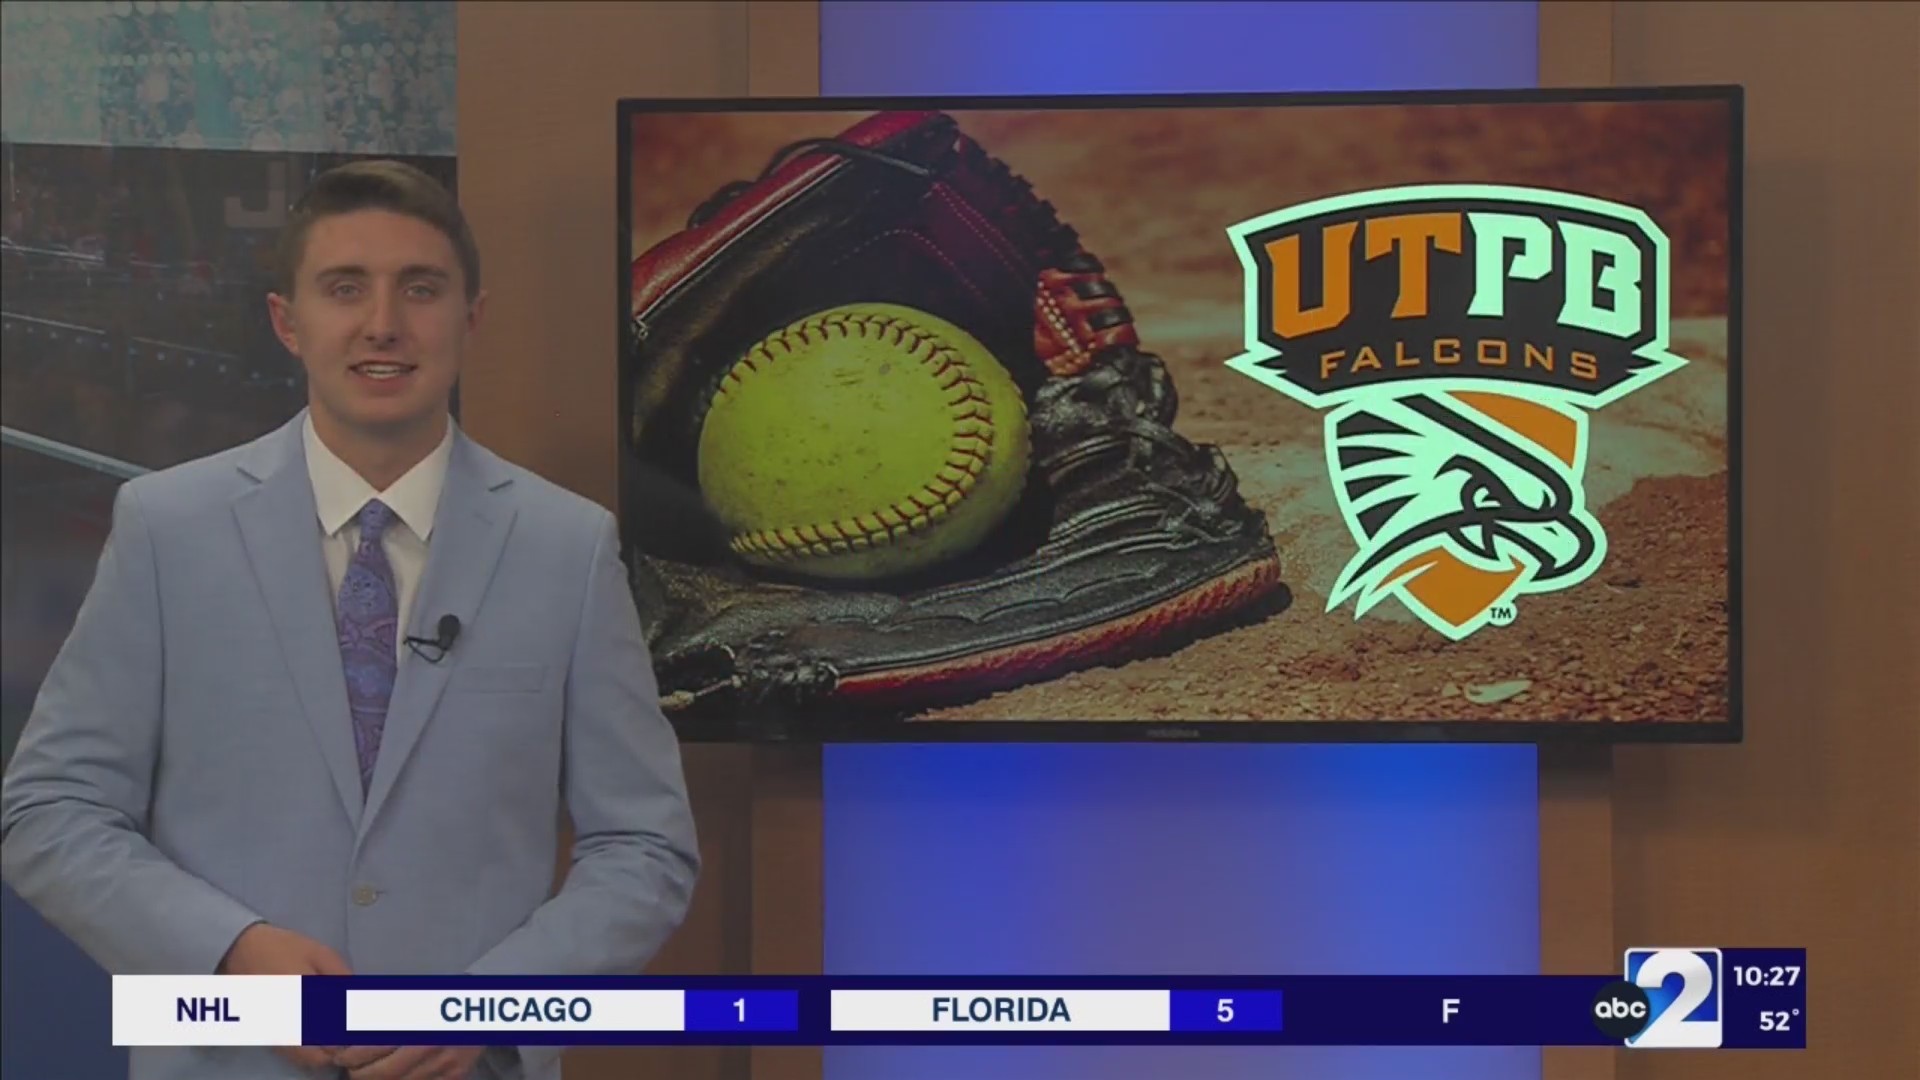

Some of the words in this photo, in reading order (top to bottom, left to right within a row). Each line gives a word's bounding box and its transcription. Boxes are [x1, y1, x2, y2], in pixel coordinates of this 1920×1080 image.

[1264, 211, 1642, 339] UTPB
[1320, 338, 1599, 379] FALCONS
[1490, 607, 1512, 619] TM
